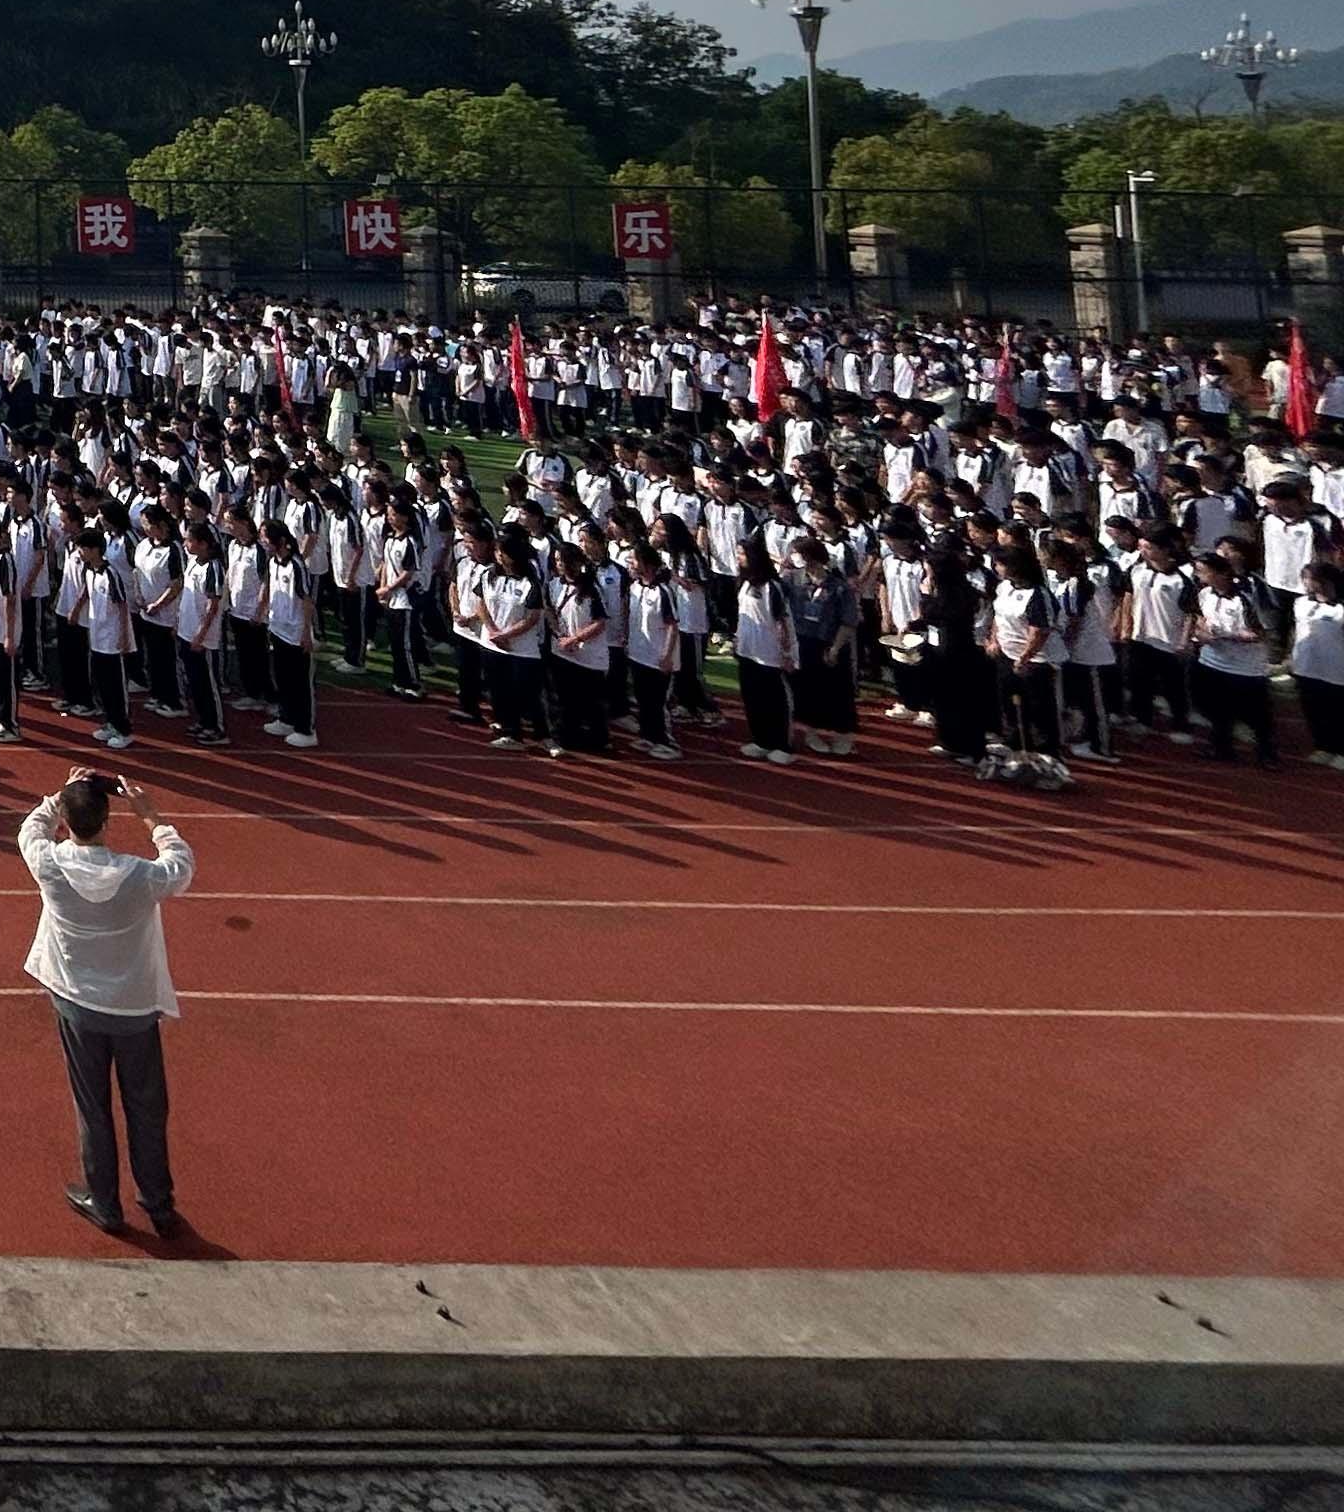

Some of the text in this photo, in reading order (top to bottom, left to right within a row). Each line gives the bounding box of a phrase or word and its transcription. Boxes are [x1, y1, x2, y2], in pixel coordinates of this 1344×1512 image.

[84, 203, 128, 248] 我
[351, 205, 396, 250] 快
[623, 210, 665, 252] 乐
